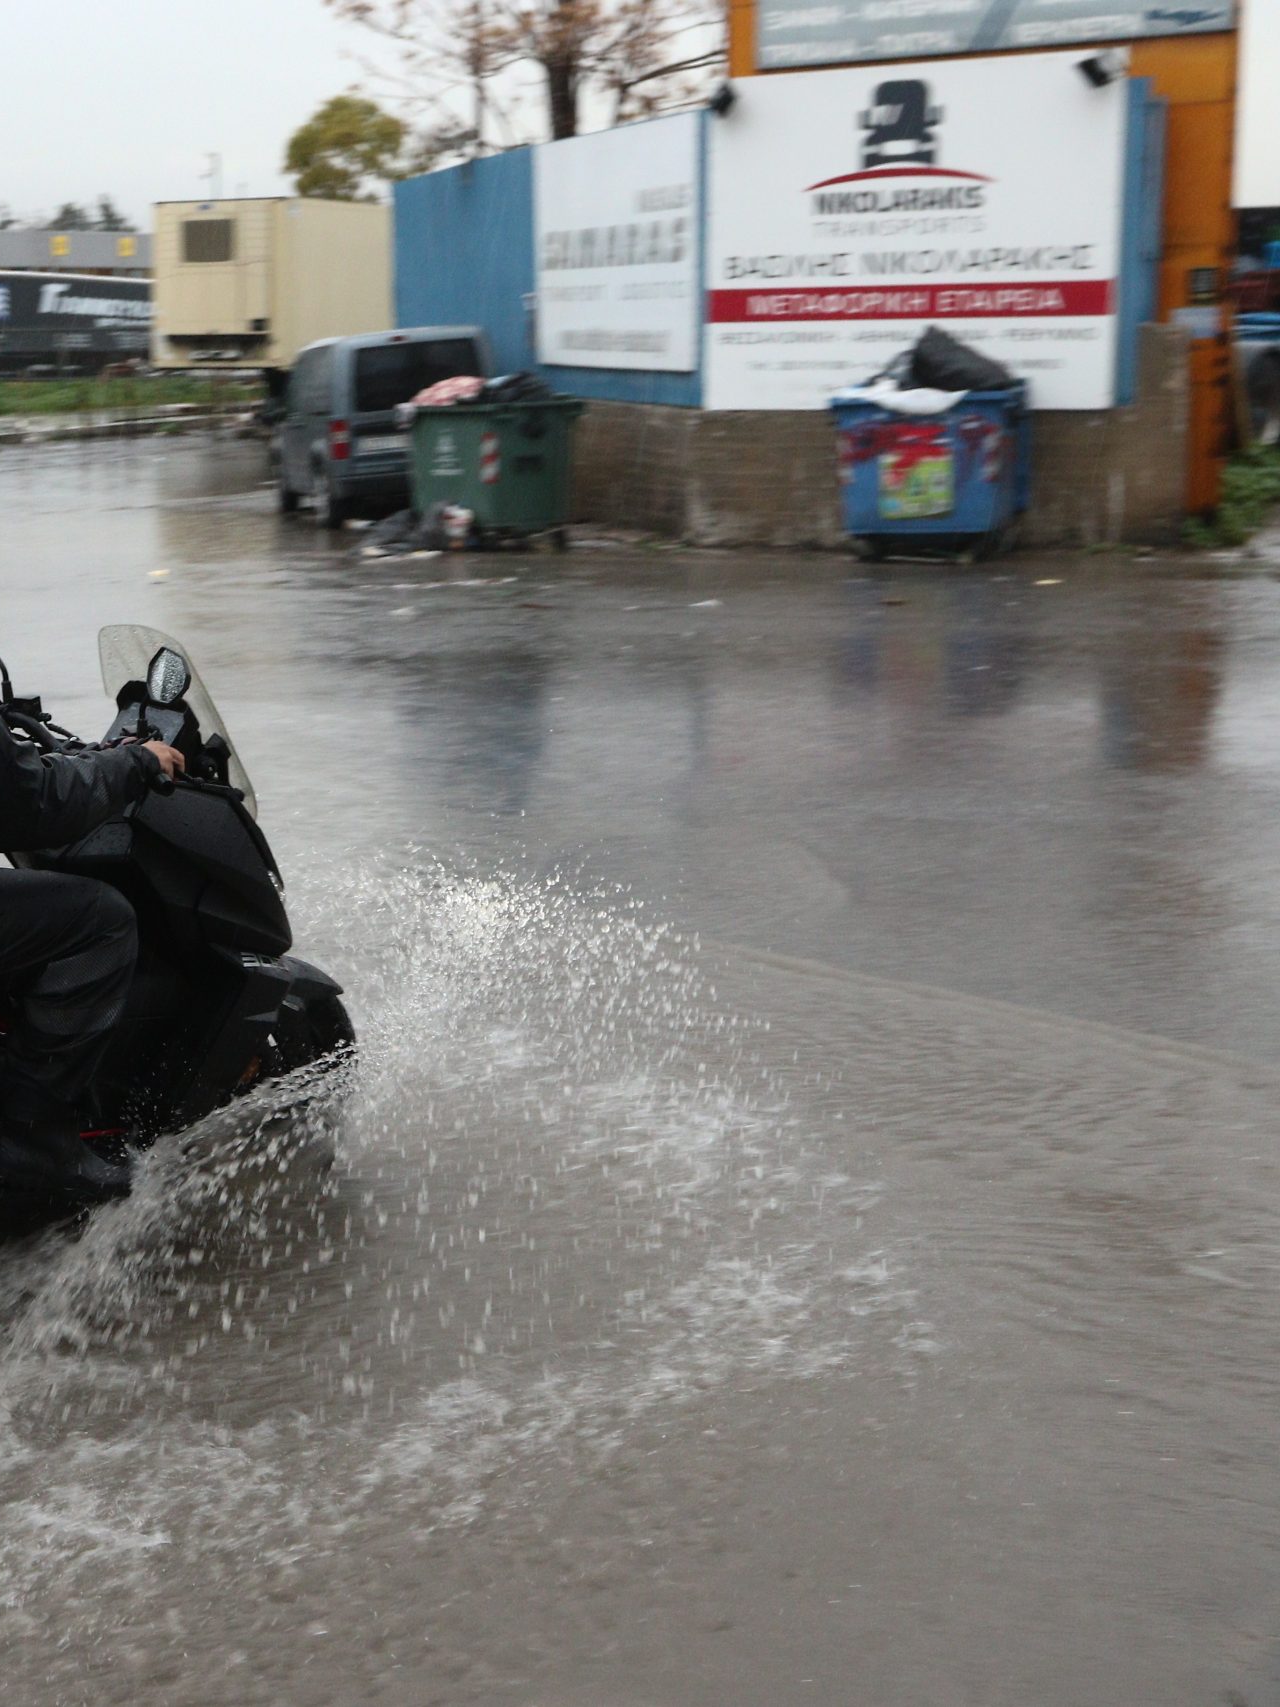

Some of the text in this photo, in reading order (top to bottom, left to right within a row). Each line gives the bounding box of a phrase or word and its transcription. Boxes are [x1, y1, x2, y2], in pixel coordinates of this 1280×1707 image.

[811, 186, 986, 215] NIKOLARAKIS
[811, 215, 987, 238] TRANSPORTS
[859, 244, 1096, 276] ΝΙΚΟΛΑΡΑΚΗΣ
[746, 288, 1066, 316] ΜΕΤΑΦΟΡΙΚΗ ΕΤΑΙΡΕΙΑ
